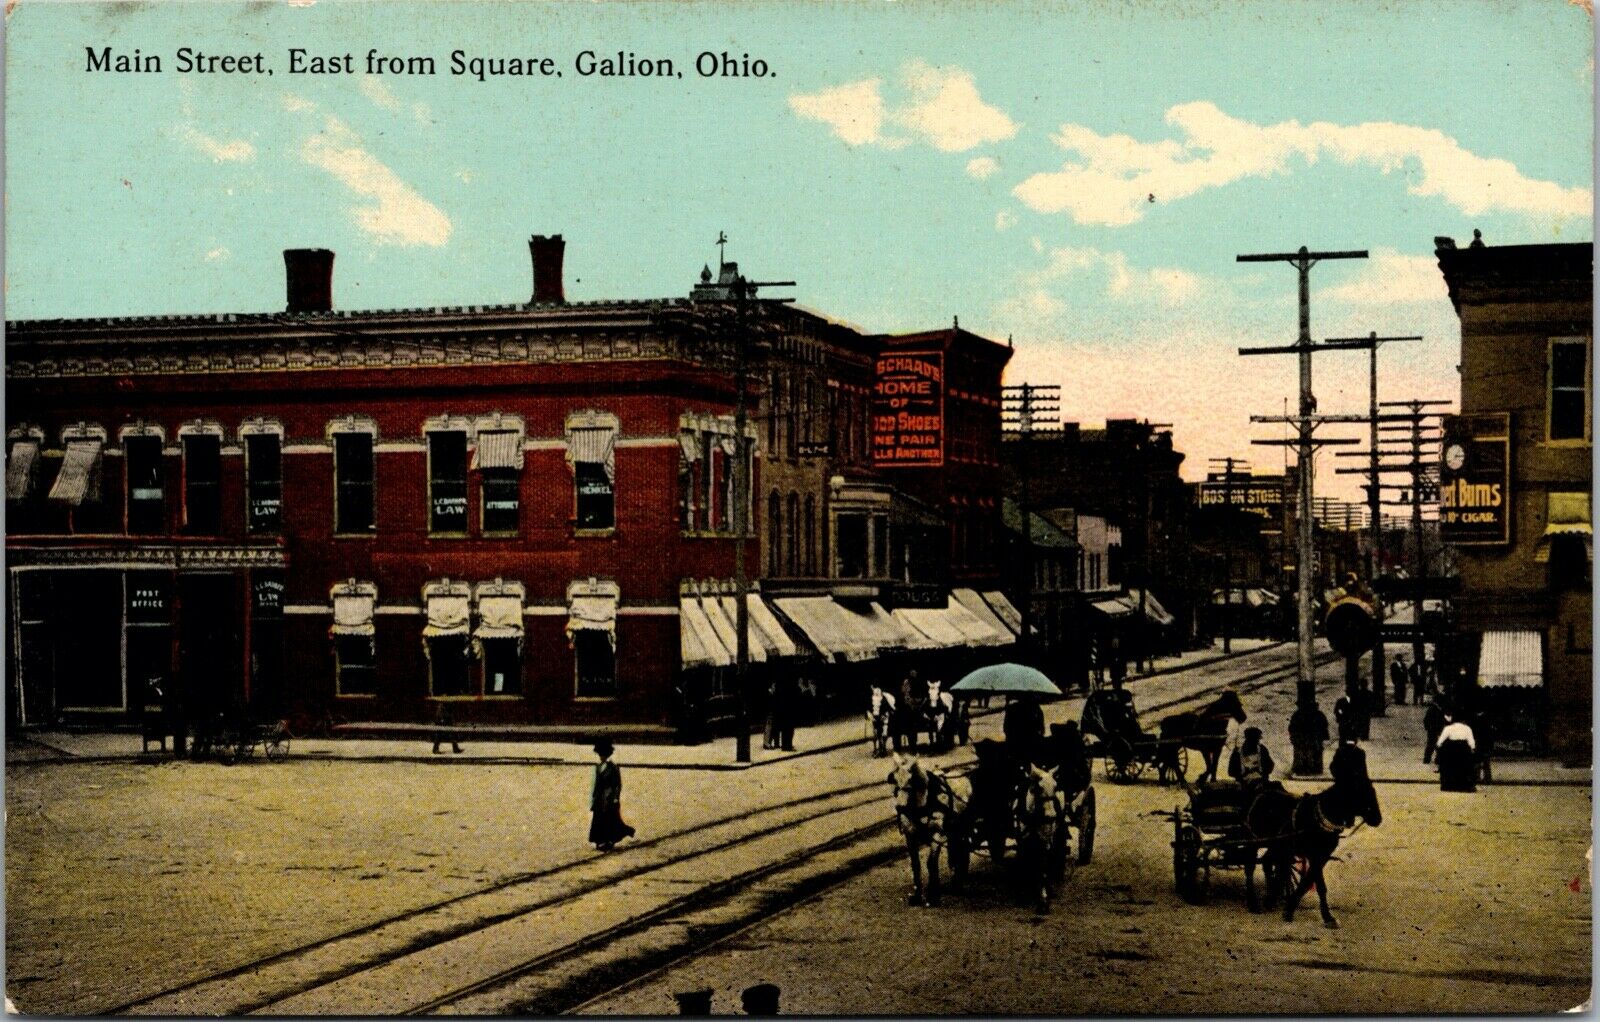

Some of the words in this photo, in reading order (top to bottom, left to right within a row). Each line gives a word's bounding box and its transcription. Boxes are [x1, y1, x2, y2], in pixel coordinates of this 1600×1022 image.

[890, 398, 909, 408] OF
[900, 434, 935, 445] PAIR
[1202, 489, 1245, 504] BOSON
[1459, 478, 1502, 508] Burns
[435, 505, 465, 515] LAW
